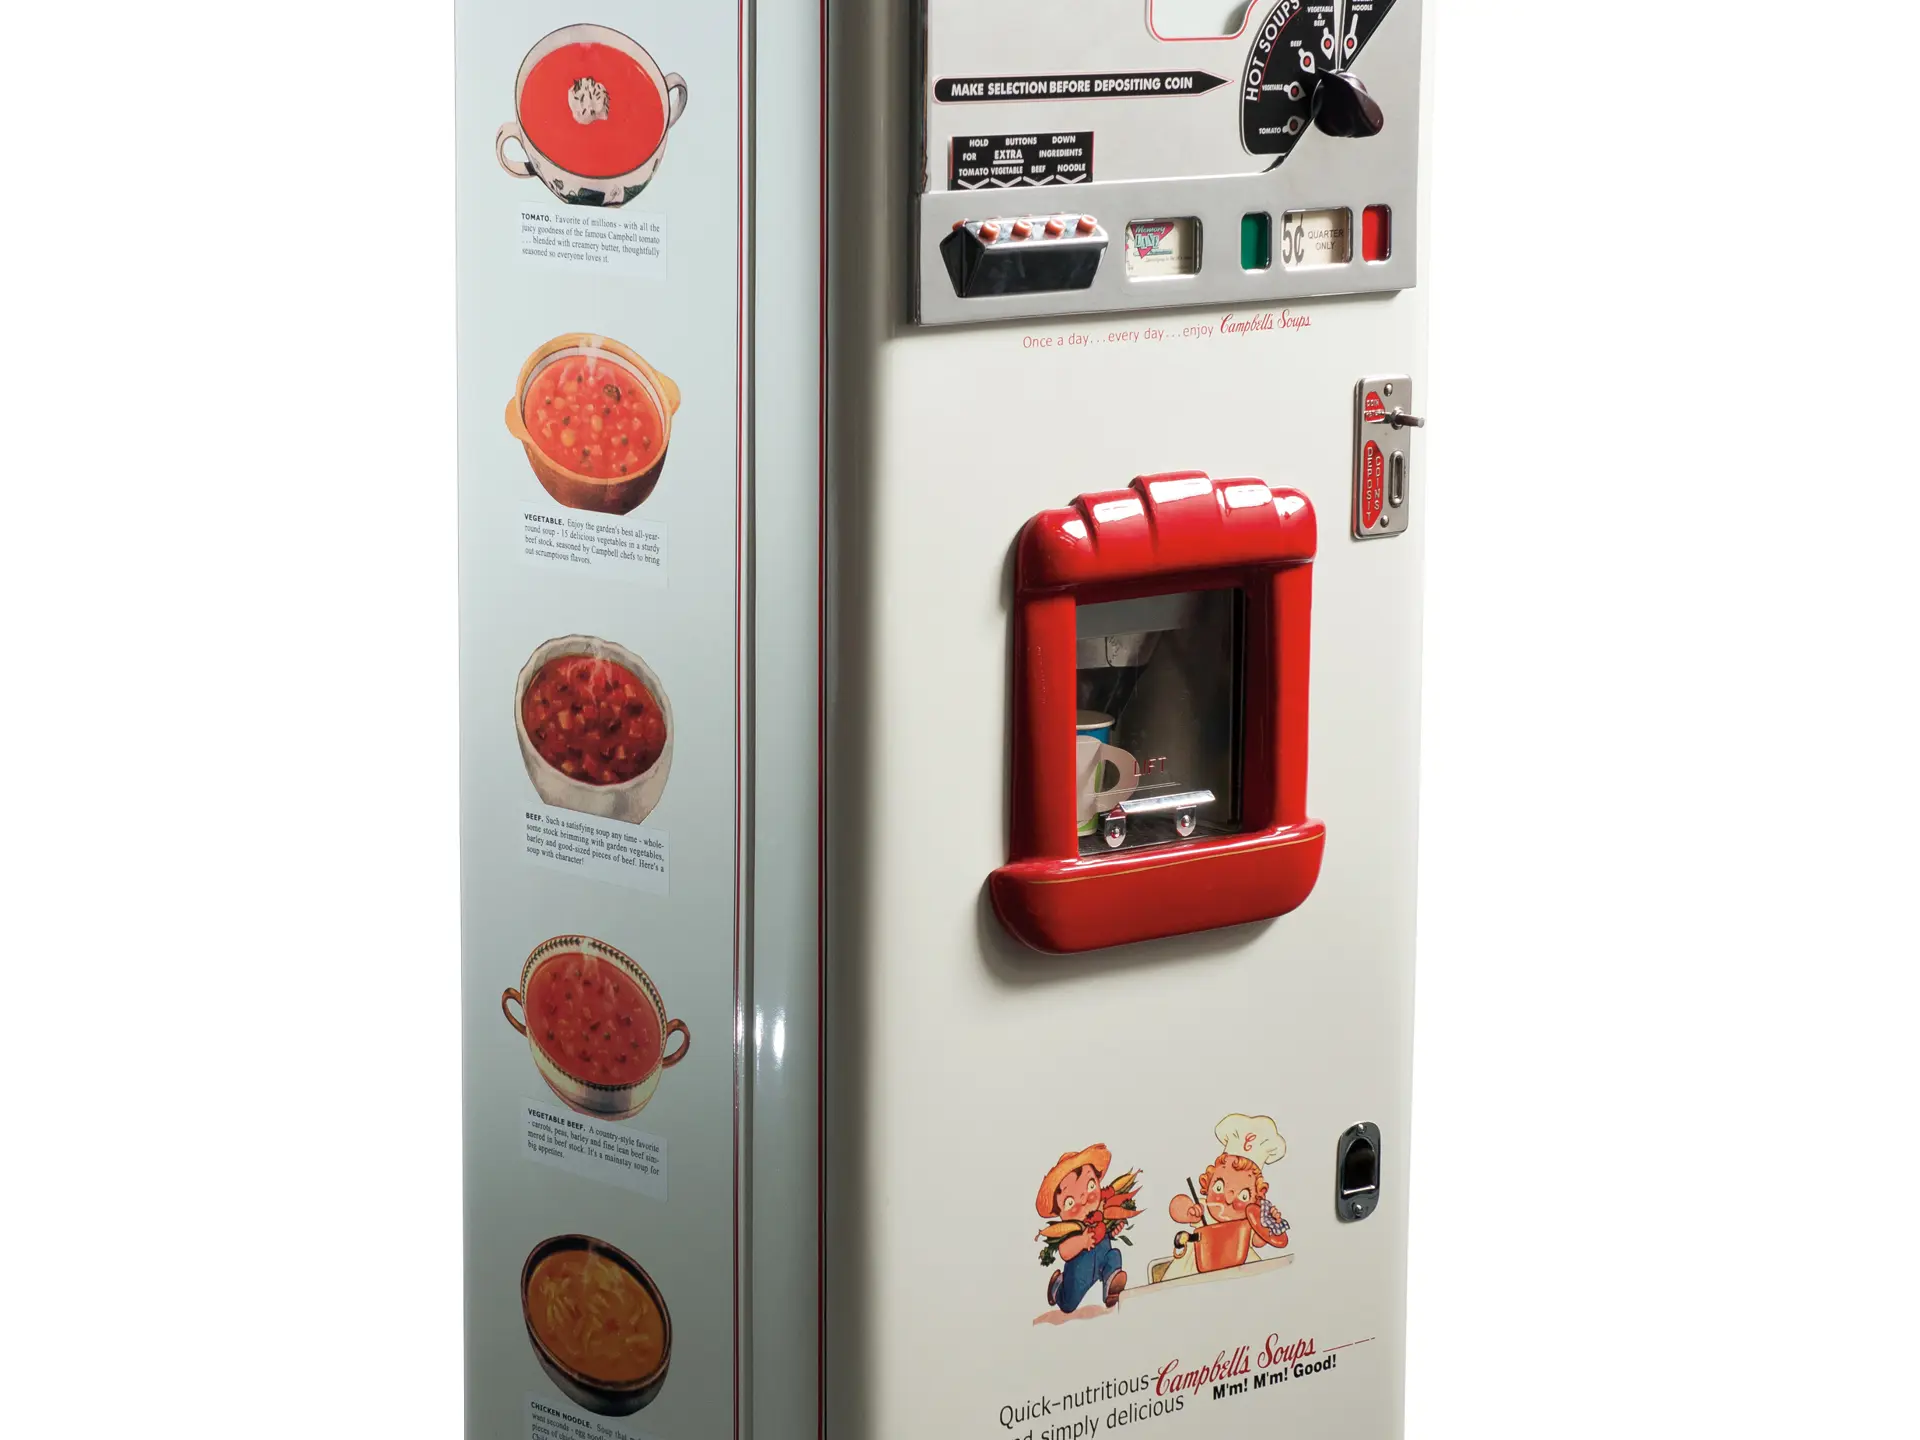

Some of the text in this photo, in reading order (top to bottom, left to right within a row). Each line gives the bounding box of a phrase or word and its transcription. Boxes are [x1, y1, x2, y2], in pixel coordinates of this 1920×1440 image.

[951, 77, 1192, 96] MAKE SELECTION BEFORE DEPOSITING COIN
[1246, 56, 1264, 101] HOT
[963, 148, 1082, 161] FOR EXTRA INGREDIENTS
[969, 136, 1075, 147] HOLD BUTTONS DOWN
[959, 164, 1086, 176] TOMATO VEGETABLE BEEF NOODLE
[522, 213, 660, 232] TOMATO. Favorite of millions with all the
[522, 225, 660, 244] juicy goodness of the famous Campbell tomato
[1308, 229, 1343, 239] QUARTER
[522, 248, 547, 256] seasoned
[557, 251, 583, 261] everyone
[586, 251, 601, 262] loves
[533, 236, 659, 257] blended with creamery butter, thoughtfully
[1220, 309, 1311, 336] Campbell's Soups
[1022, 336, 1052, 348] Once
[1057, 338, 1063, 346] a
[524, 513, 659, 541] VEGETABLE. Enjoy the garden's best all-year-
[525, 525, 540, 533] round
[543, 528, 555, 537] soup
[561, 529, 568, 537] 15
[570, 531, 595, 542] delicious
[597, 536, 627, 547] vegetables
[642, 543, 660, 553] sturdy
[525, 535, 660, 566] beef stock, seasoned by Campbell chefs to bring
[536, 549, 568, 561] scrumptious
[570, 552, 591, 564] flavors.
[1133, 756, 1167, 776] LIFT
[526, 812, 543, 822] BEEF.
[546, 815, 559, 826] Such
[566, 820, 594, 835] satisfying
[596, 827, 610, 838] soup
[612, 831, 622, 841] any
[624, 833, 637, 843] time
[644, 838, 664, 849] whole-
[527, 824, 664, 861] some stock brimming with garden vegetables,
[527, 833, 543, 845] barley
[546, 838, 556, 848] and
[558, 841, 590, 856] good-sized
[592, 849, 611, 860] pieces
[613, 853, 620, 862] of
[622, 855, 636, 866] beef.
[639, 858, 658, 871] Here's
[527, 846, 584, 865] soup with character!
[528, 1108, 565, 1125] VEGETABLE
[567, 1119, 586, 1131] BEEF.
[596, 1127, 634, 1146] country-style
[636, 1137, 659, 1152] favorite
[532, 1121, 553, 1134] carrots,
[554, 1127, 568, 1138] peas,
[571, 1130, 588, 1144] barley
[590, 1137, 600, 1146] and
[603, 1140, 614, 1150] fine
[617, 1143, 629, 1155] lean
[631, 1148, 644, 1160] beef
[528, 1140, 537, 1151] big
[547, 1134, 552, 1143] in
[554, 1137, 567, 1148] beef
[569, 1143, 584, 1153] stock.
[588, 1147, 597, 1157] It's
[605, 1153, 632, 1169] mainstay
[634, 1161, 648, 1174] soup
[650, 1164, 659, 1175] for
[1156, 1332, 1316, 1396] Campbell's Soups
[1212, 1354, 1336, 1400] M'm! M'm! Good!
[531, 1401, 560, 1417] CHICKEN
[563, 1413, 592, 1428] NOODLE.
[1041, 1395, 1184, 1440] simply delicious
